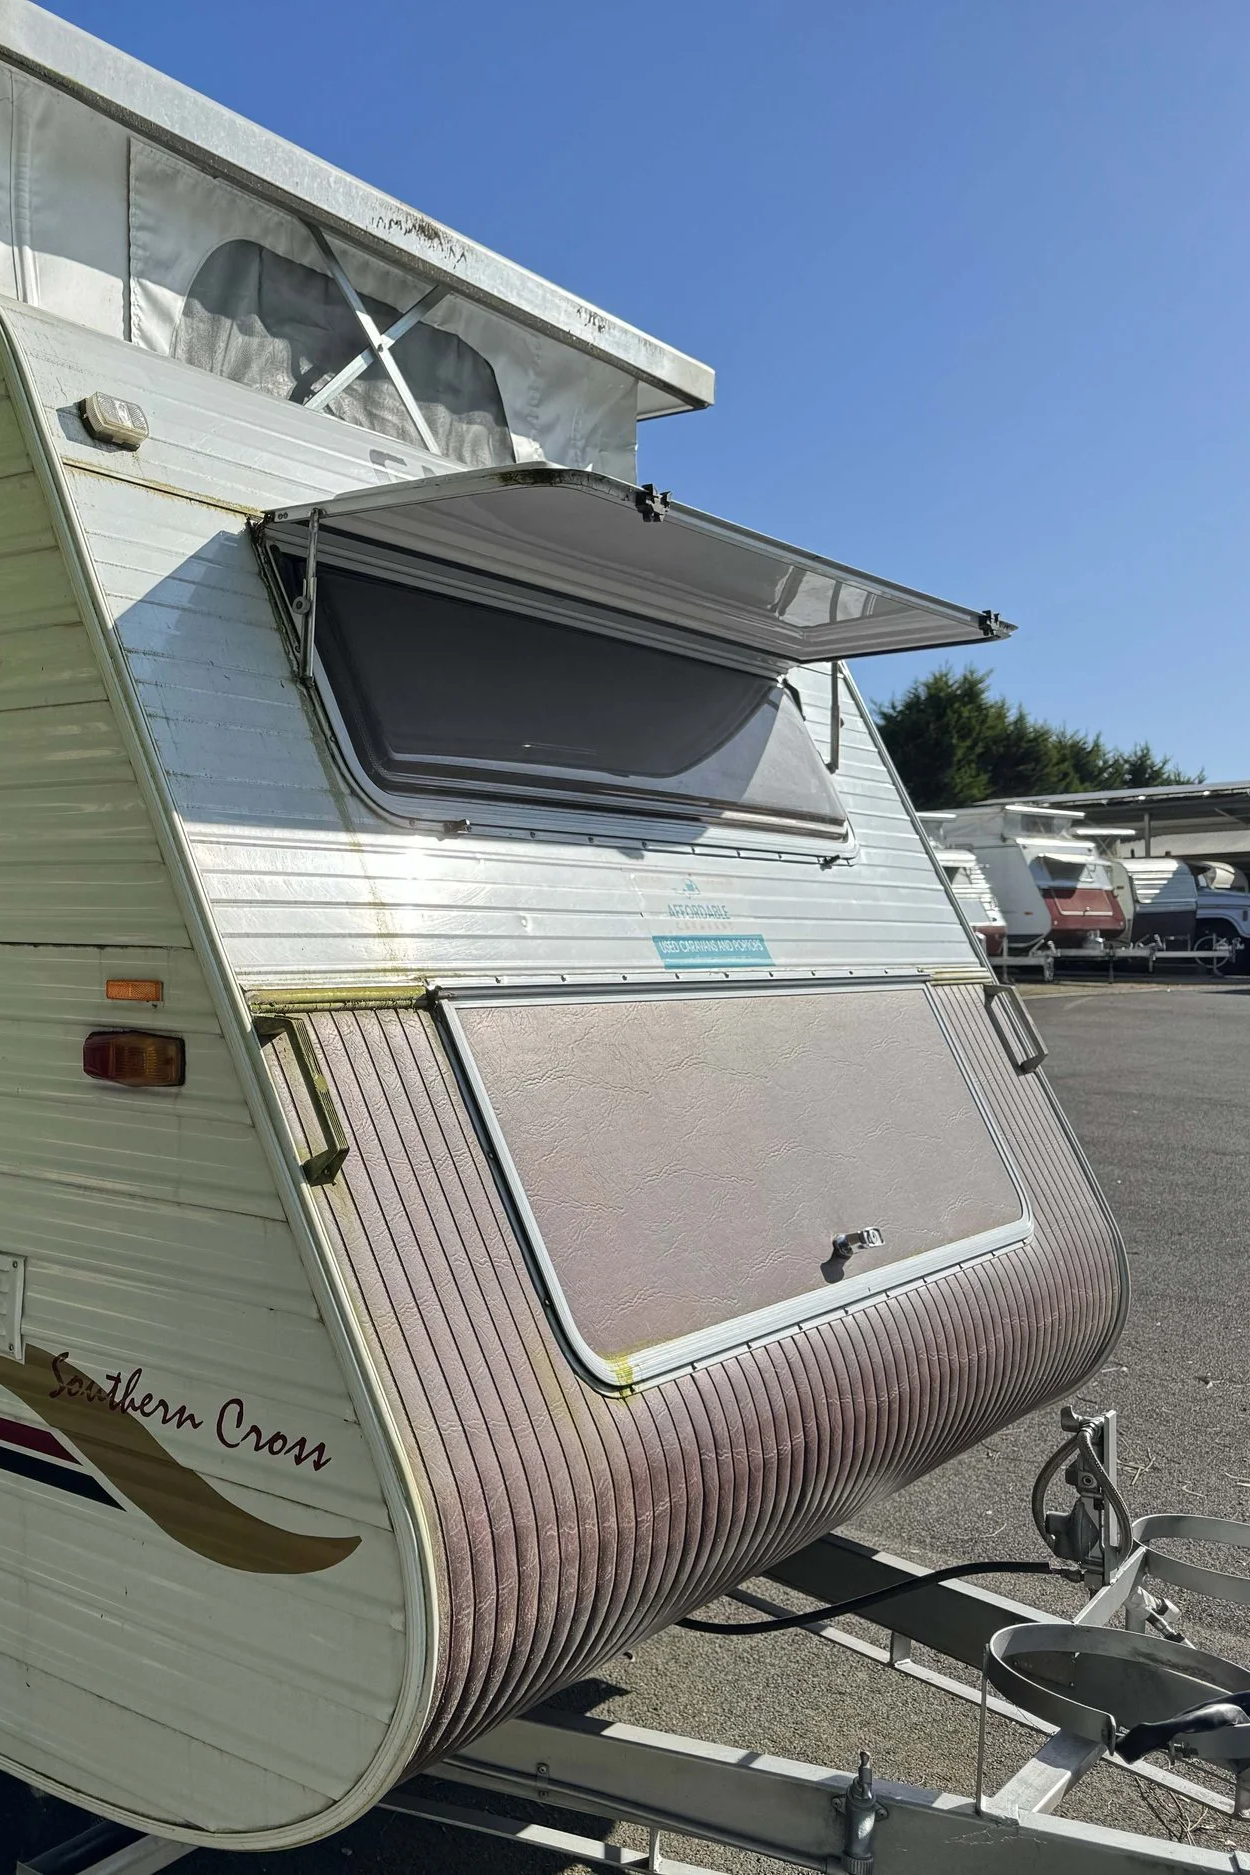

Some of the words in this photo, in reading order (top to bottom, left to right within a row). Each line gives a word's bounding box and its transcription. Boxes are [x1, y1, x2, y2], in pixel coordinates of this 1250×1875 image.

[667, 904, 731, 920] AFFORDABLE
[659, 940, 680, 953] USED
[718, 940, 734, 952] AND
[49, 1351, 203, 1430] Southern
[216, 1398, 332, 1472] Cross
